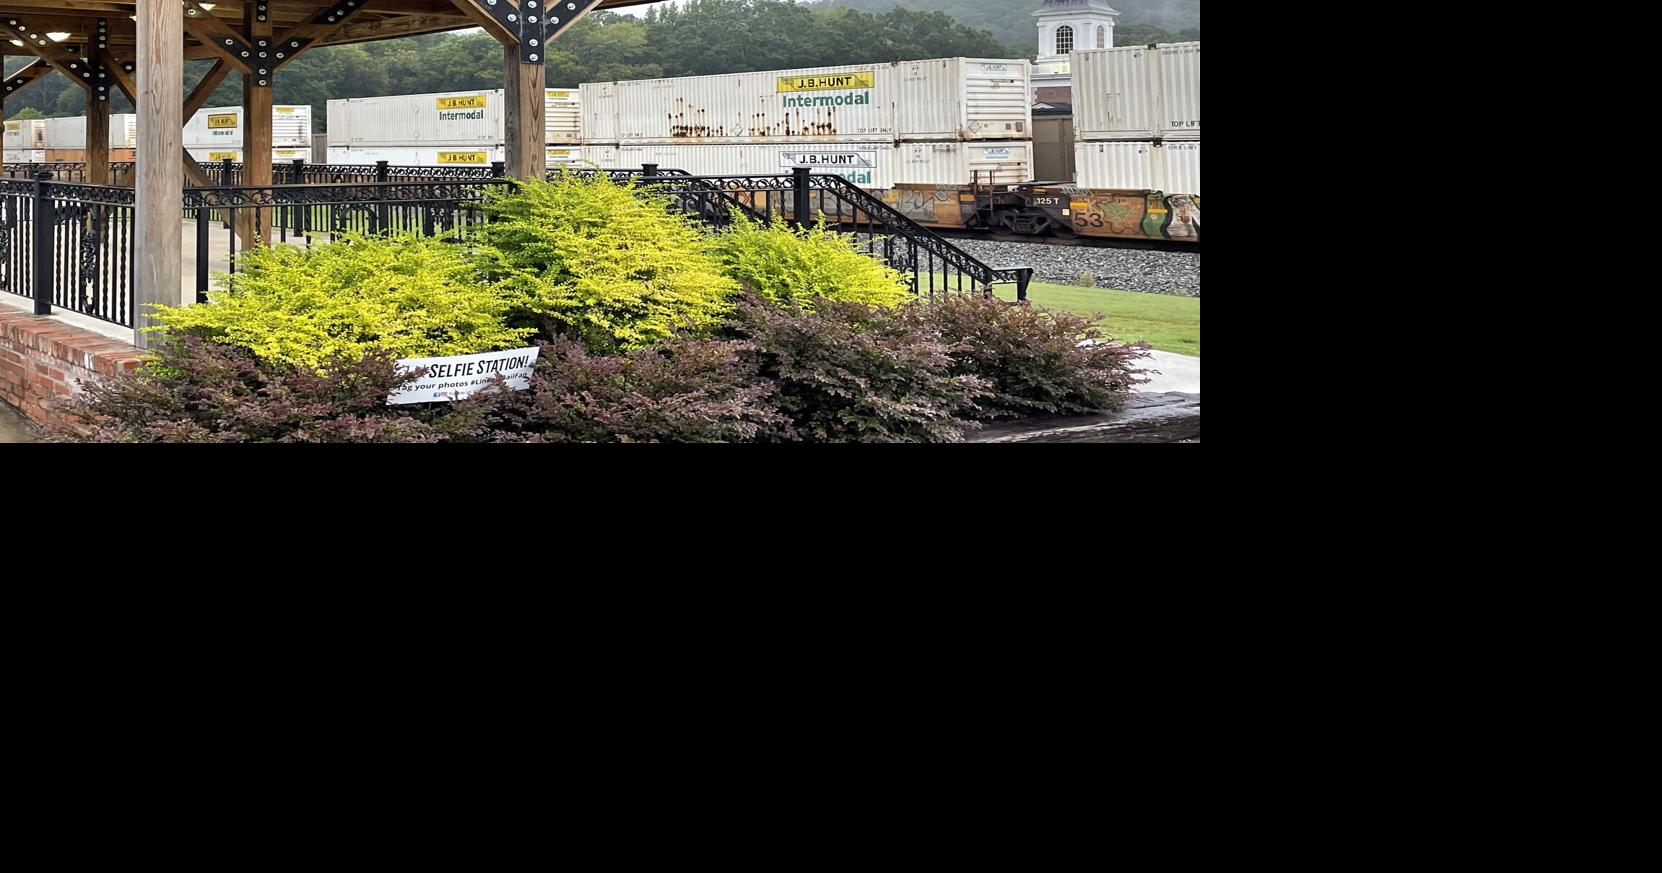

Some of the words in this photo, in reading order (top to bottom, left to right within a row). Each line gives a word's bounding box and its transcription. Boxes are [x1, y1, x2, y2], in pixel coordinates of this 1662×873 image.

[783, 91, 869, 108] Intermodal
[440, 110, 484, 121] Intermodal
[1037, 197, 1052, 205] 125
[1053, 197, 1060, 205] T
[1074, 212, 1104, 228] 53
[428, 362, 475, 378] SELFIE
[476, 355, 529, 375] STATION!
[415, 383, 436, 391] your
[438, 380, 468, 390] photos
